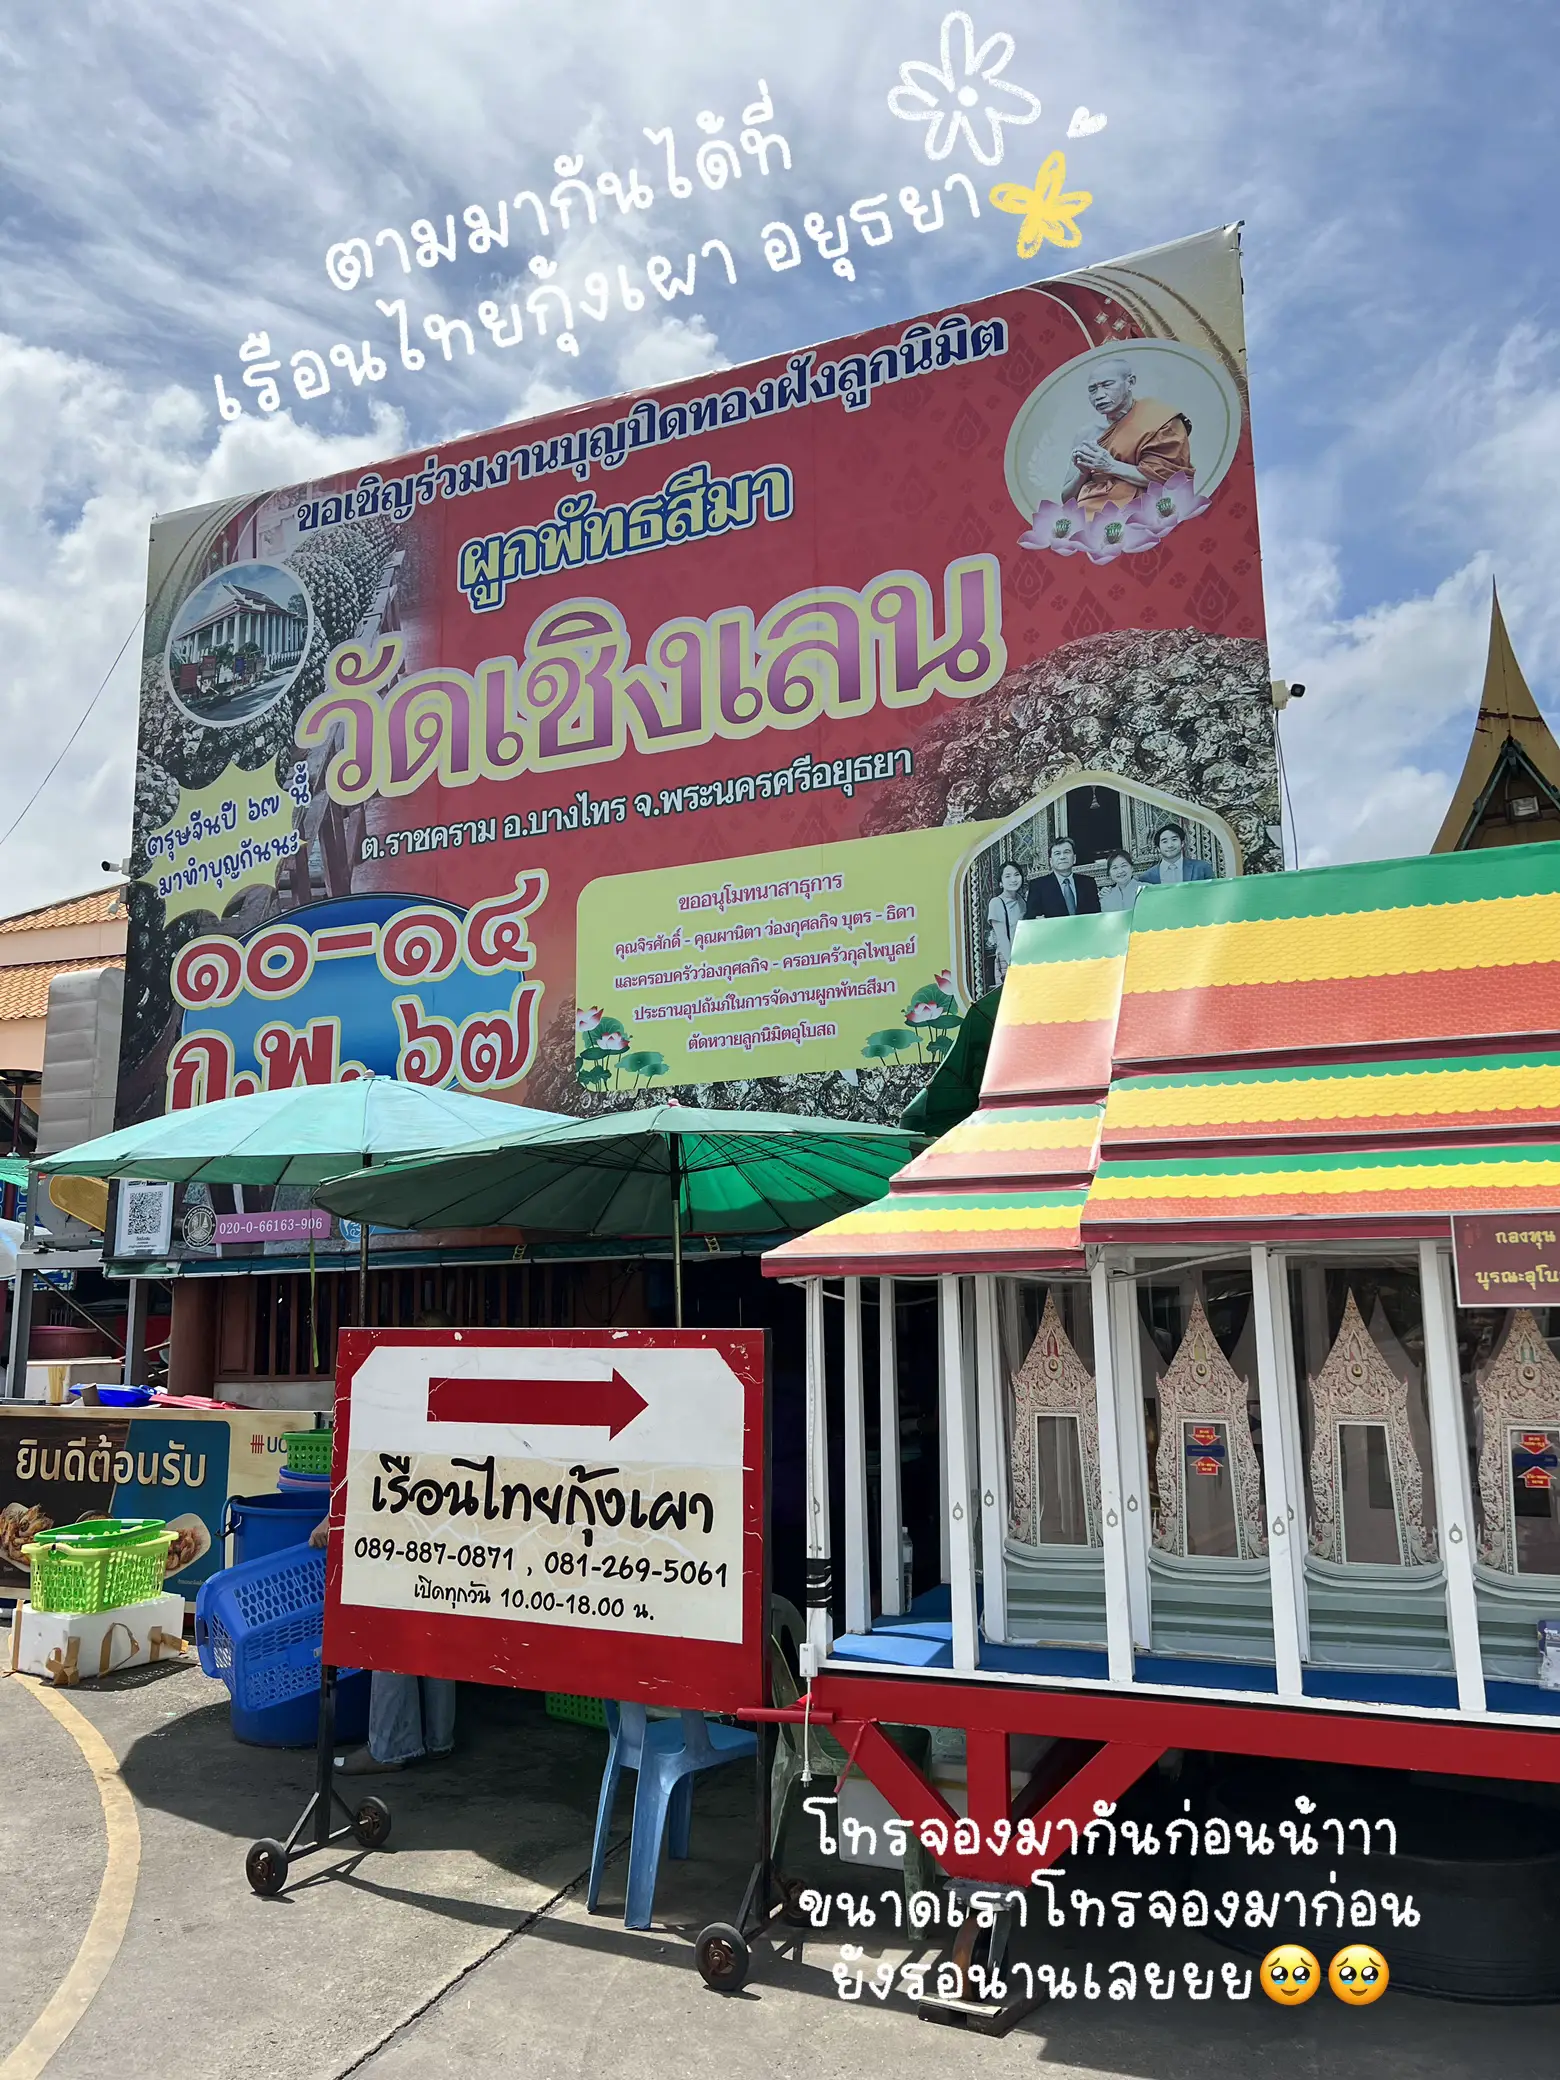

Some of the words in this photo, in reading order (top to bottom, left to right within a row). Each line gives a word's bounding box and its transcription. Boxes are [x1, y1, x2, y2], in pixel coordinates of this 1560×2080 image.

[297, 316, 1006, 532] ขอเชิญร่วมงานบุญปิดทองฝังลูกนิมิต
[459, 462, 791, 610] ผูกพัทธสีมา
[300, 561, 1000, 799] วัดเชิงเลน
[147, 800, 238, 862] ตรุษจีนปี
[248, 794, 281, 822] ๖๗
[290, 762, 310, 806] นี้
[359, 816, 497, 861] ต.ราชคราม
[502, 791, 626, 840] อ.บางไทร
[632, 745, 913, 818] จ.พระนครศรีอยุธยา
[158, 831, 301, 897] มาทำบุญกันนะ
[678, 872, 843, 912] ขออนุโมทนาสาธุการ
[842, 909, 872, 931] บุตร
[885, 904, 915, 922] ธิดา
[397, 985, 540, 1088] ๖๗
[688, 1021, 837, 1051] ตัดหวายลูกนิมิตอุโบสถ
[219, 1217, 323, 1235] 020-0-66163-906
[1474, 1263, 1560, 1291] บูรณะอุโบ
[15, 1434, 208, 1488] ยินดีต้อนรับ
[371, 1452, 716, 1547] เรือนไทยกุ้งเผา
[353, 1535, 515, 1572] 089-887-0871
[544, 1551, 729, 1588] 081-269-5061
[413, 1574, 491, 1610] เปิดทุกวัน
[500, 1588, 625, 1619] 10.00-18.00
[632, 1602, 656, 1622] น.
